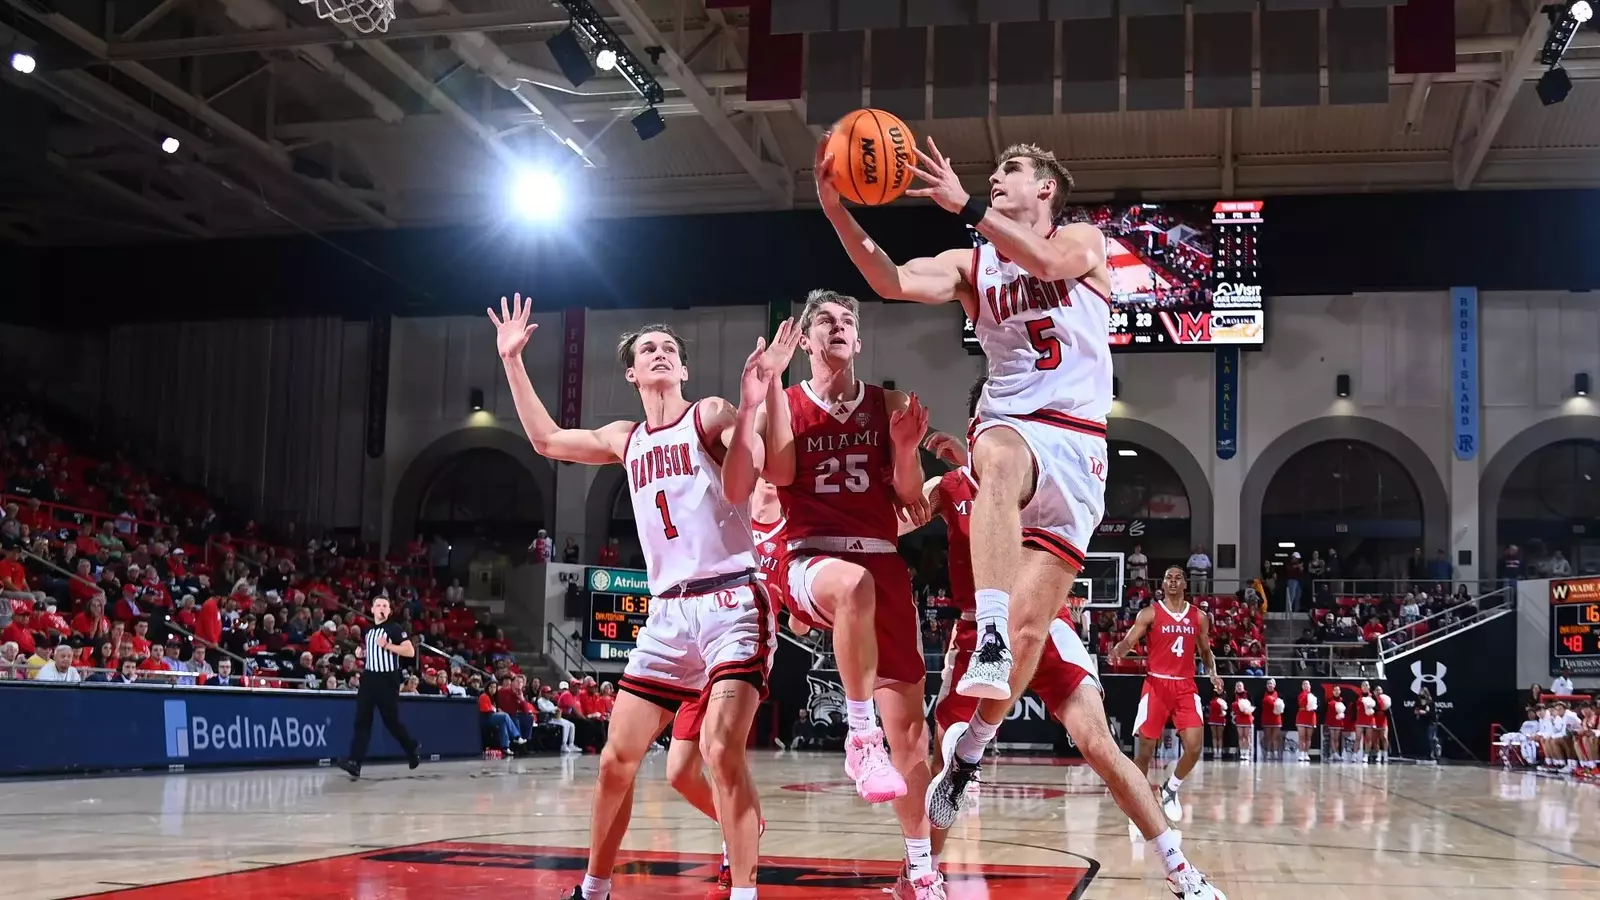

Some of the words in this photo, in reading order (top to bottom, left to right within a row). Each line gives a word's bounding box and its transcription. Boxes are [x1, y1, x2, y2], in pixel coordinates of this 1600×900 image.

[861, 137, 878, 184] NCAA
[1135, 312, 1153, 328] 23
[1459, 297, 1469, 352] RHODE
[1024, 316, 1062, 371] 5
[565, 328, 578, 428] FORDHAM
[1223, 356, 1231, 374] LA
[1460, 358, 1470, 426] ISLAND
[806, 429, 879, 453] MIAMI
[631, 443, 694, 494] DAVDSON
[815, 454, 870, 494] 25
[655, 489, 679, 541] 1
[613, 576, 648, 589] Atrium
[621, 595, 651, 614] 16:3
[598, 622, 617, 639] 48
[1161, 625, 1195, 635] MIAMI
[1563, 635, 1583, 652] 48
[1170, 635, 1184, 658] 4
[192, 715, 327, 750] BedInABox
